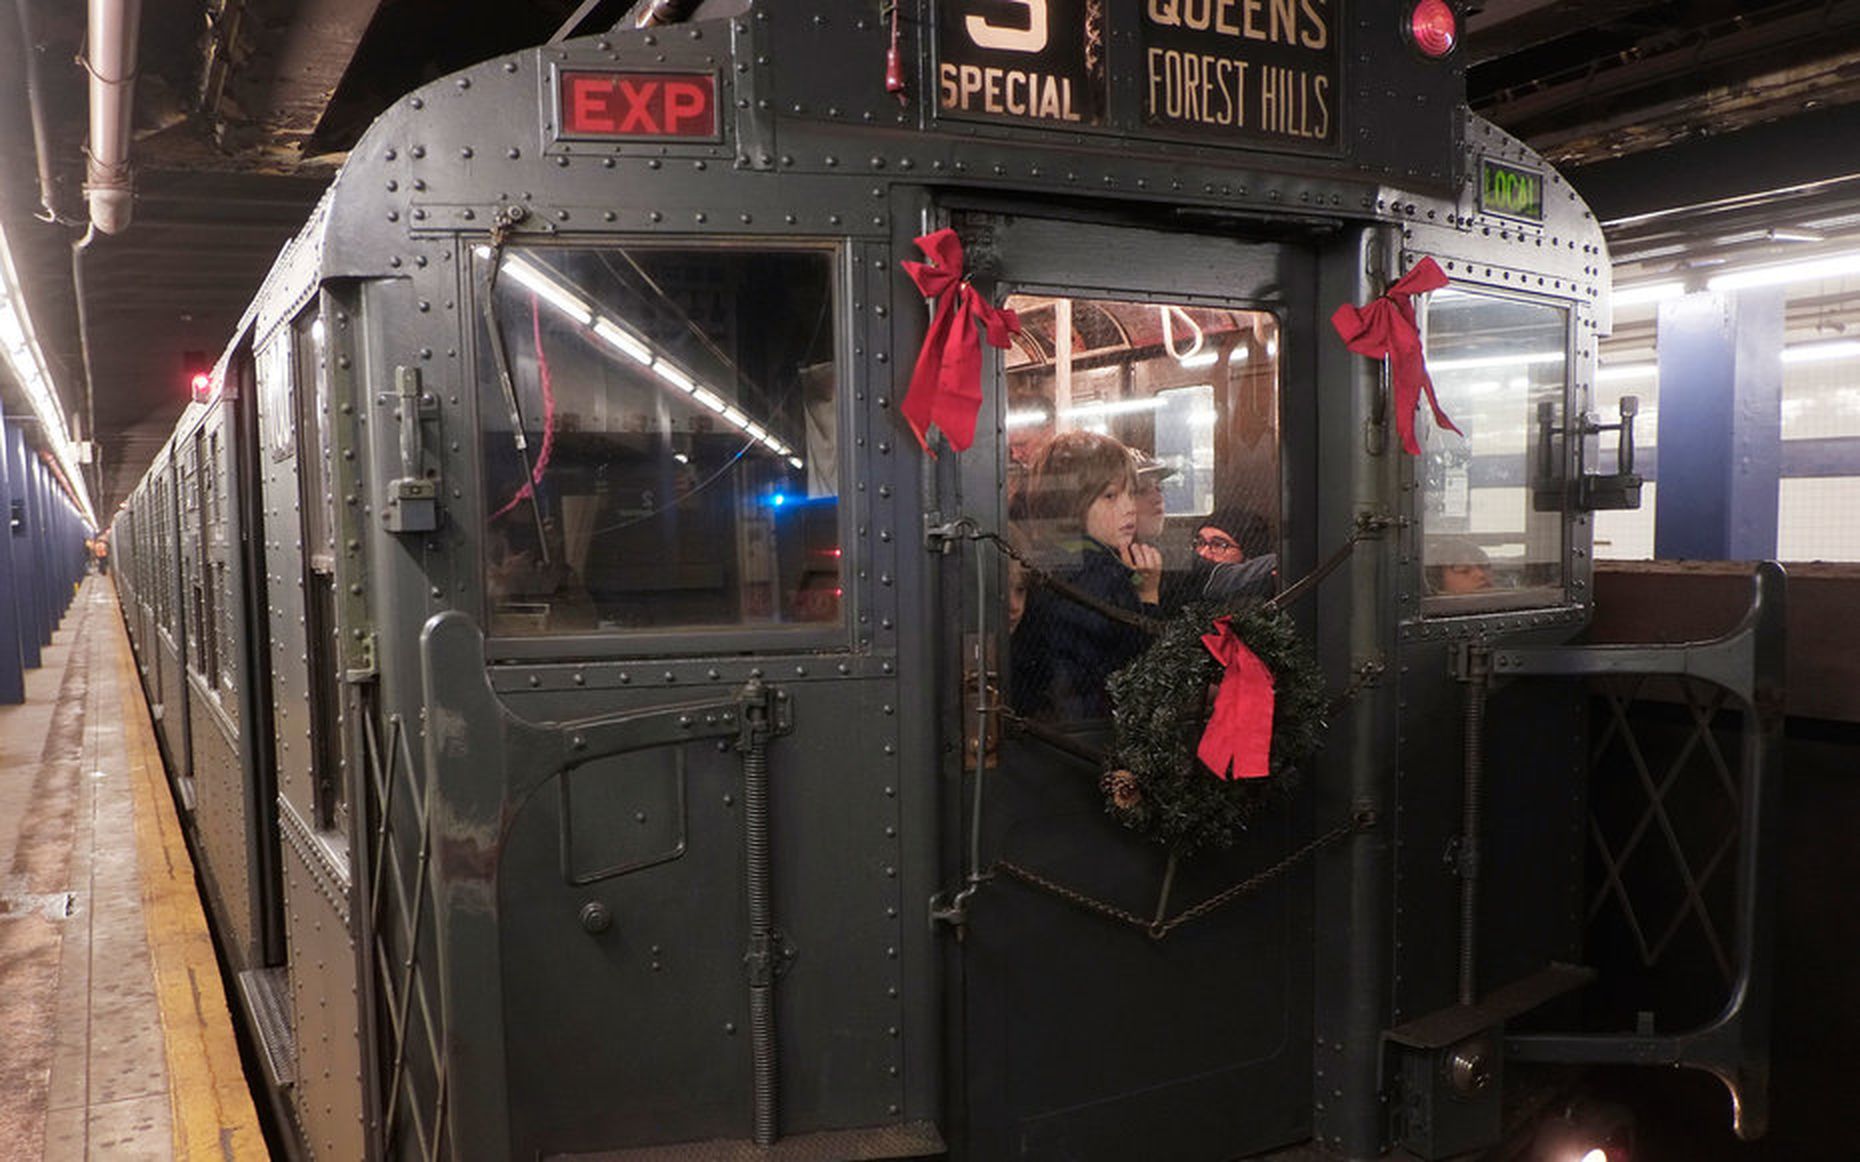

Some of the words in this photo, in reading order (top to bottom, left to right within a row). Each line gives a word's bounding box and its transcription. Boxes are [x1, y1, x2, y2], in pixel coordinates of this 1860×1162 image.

[573, 79, 705, 133] EXP
[940, 63, 1081, 122] SPECIAL
[1147, 48, 1248, 128] FOREST
[1261, 65, 1329, 139] HILLS
